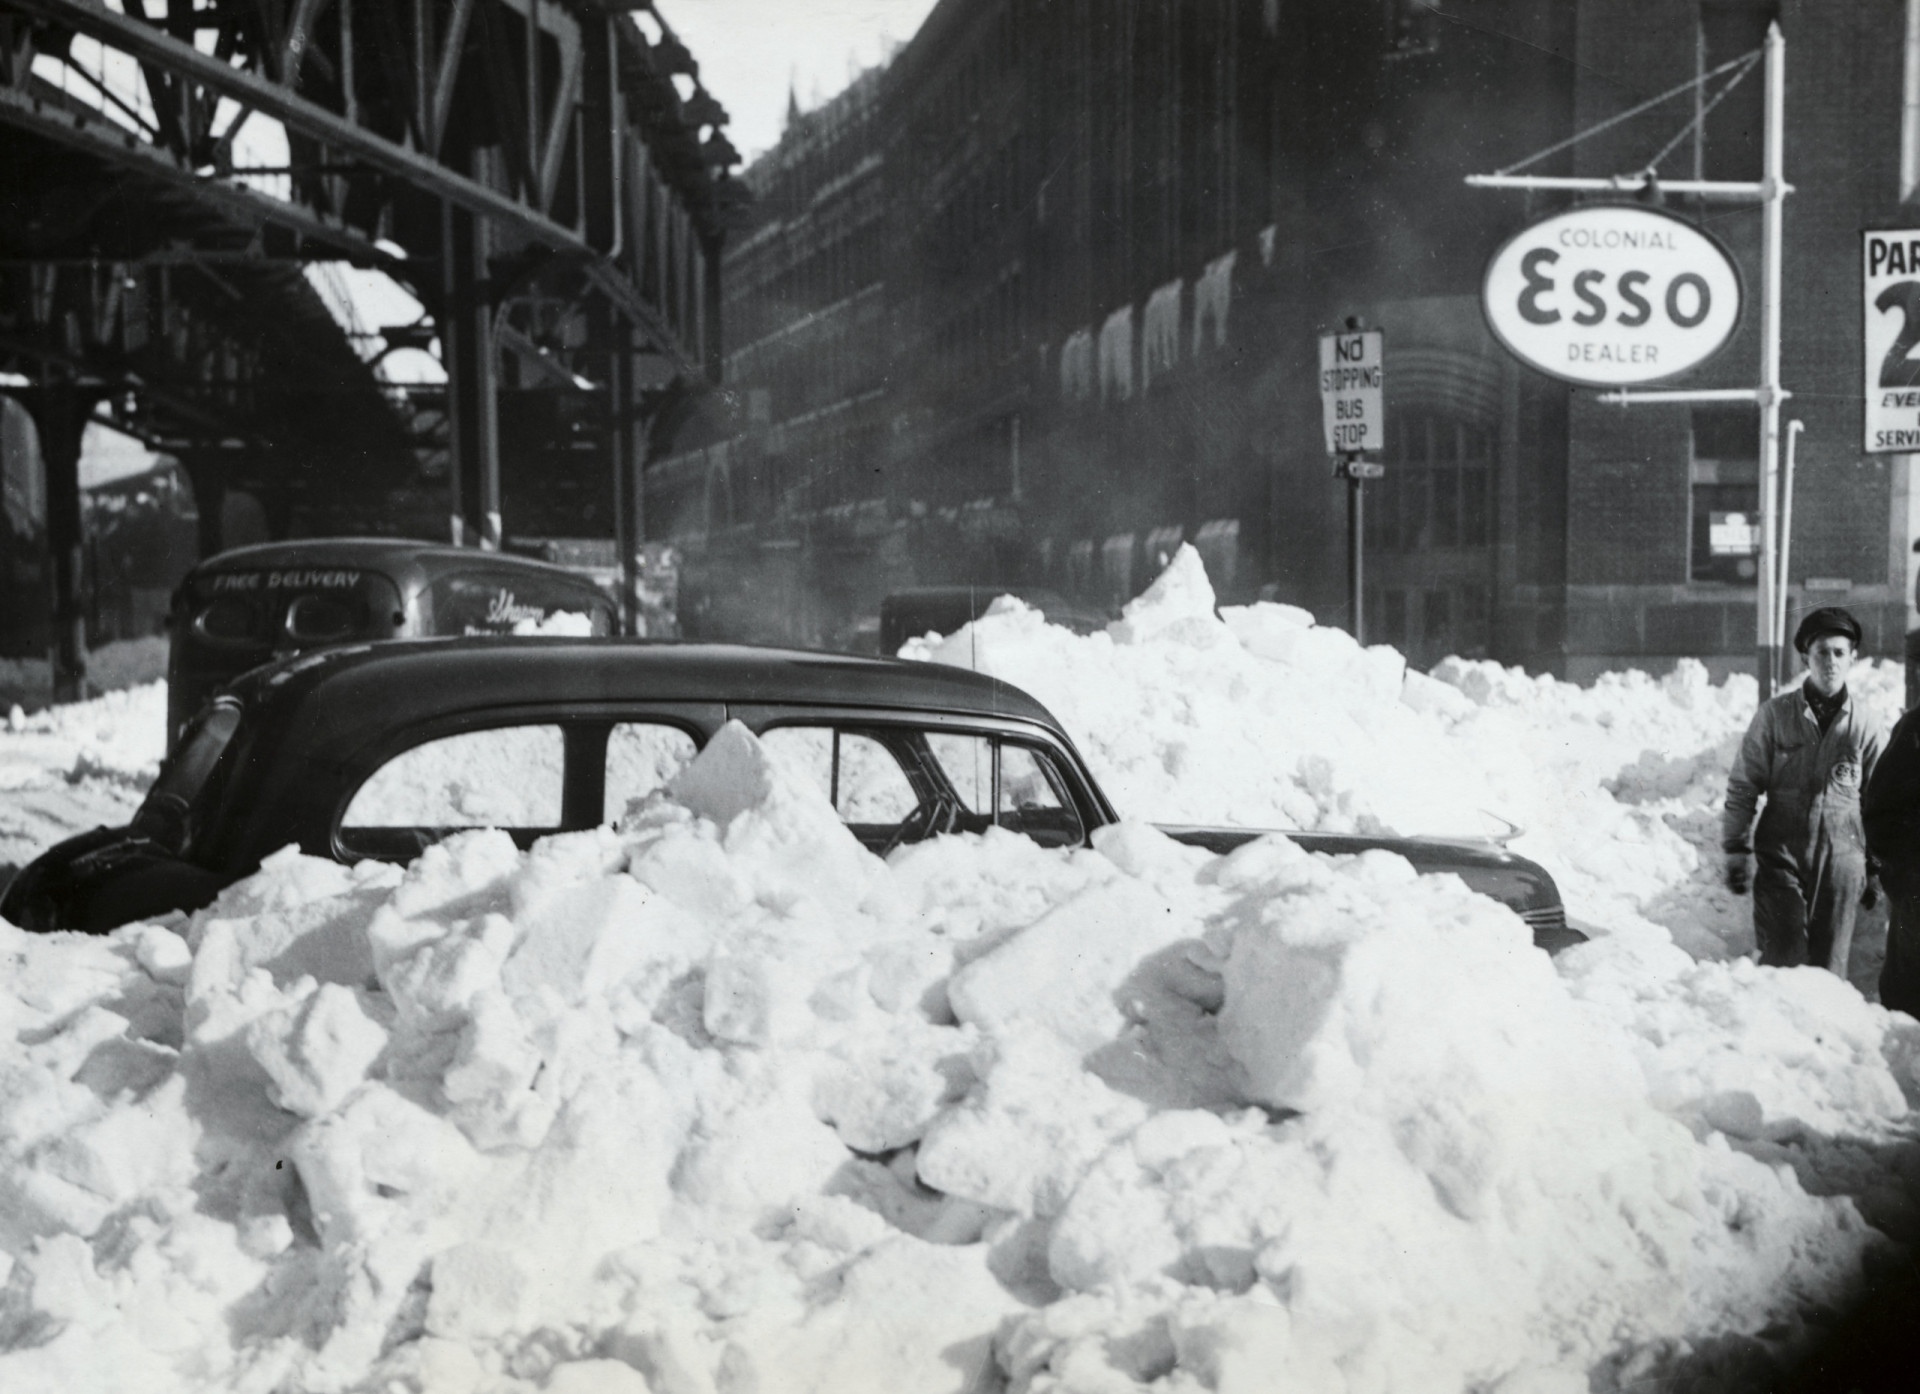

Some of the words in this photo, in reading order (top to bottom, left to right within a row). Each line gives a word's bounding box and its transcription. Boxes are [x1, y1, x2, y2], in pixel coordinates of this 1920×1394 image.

[1559, 228, 1677, 250] COLONIAL
[1336, 335, 1364, 362] NO
[1568, 343, 1658, 363] DEALER
[1323, 366, 1381, 392] STOPPING
[1336, 398, 1364, 420] BUS
[1881, 391, 1920, 408] EVE
[1334, 423, 1368, 444] STOP
[213, 573, 260, 590] FREE
[268, 571, 361, 589] DELIVERY
